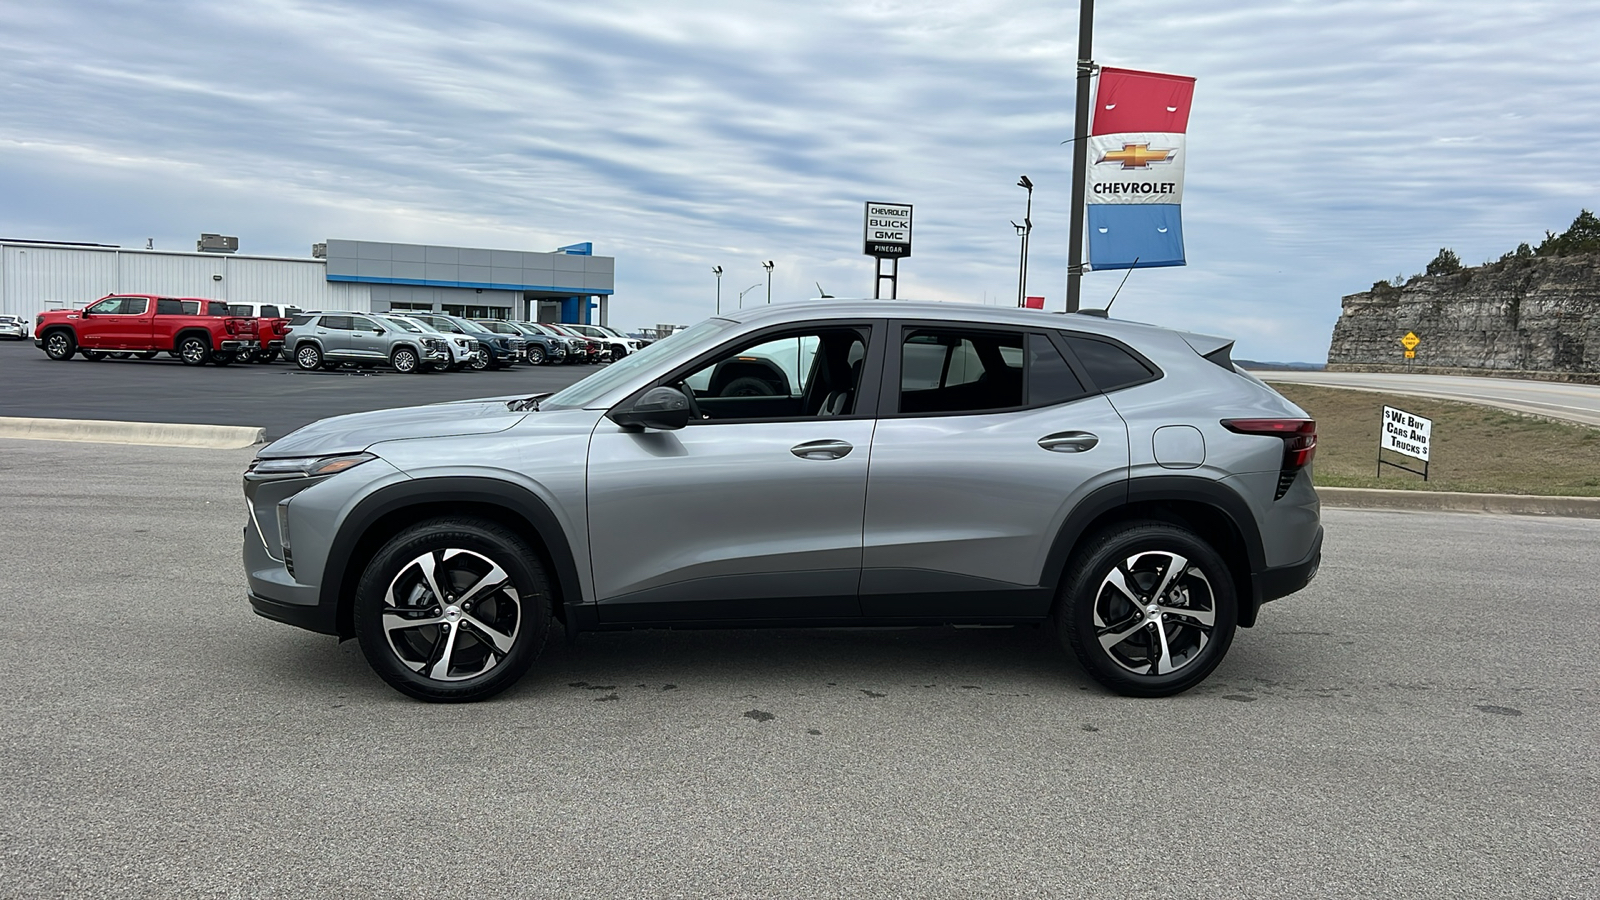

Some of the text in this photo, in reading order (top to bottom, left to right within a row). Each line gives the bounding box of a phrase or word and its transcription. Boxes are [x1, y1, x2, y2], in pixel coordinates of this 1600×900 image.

[1093, 183, 1175, 194] CHEVROLET
[871, 208, 908, 216] CHEVROLET
[870, 220, 908, 228] BUICK
[875, 231, 903, 240] GMC
